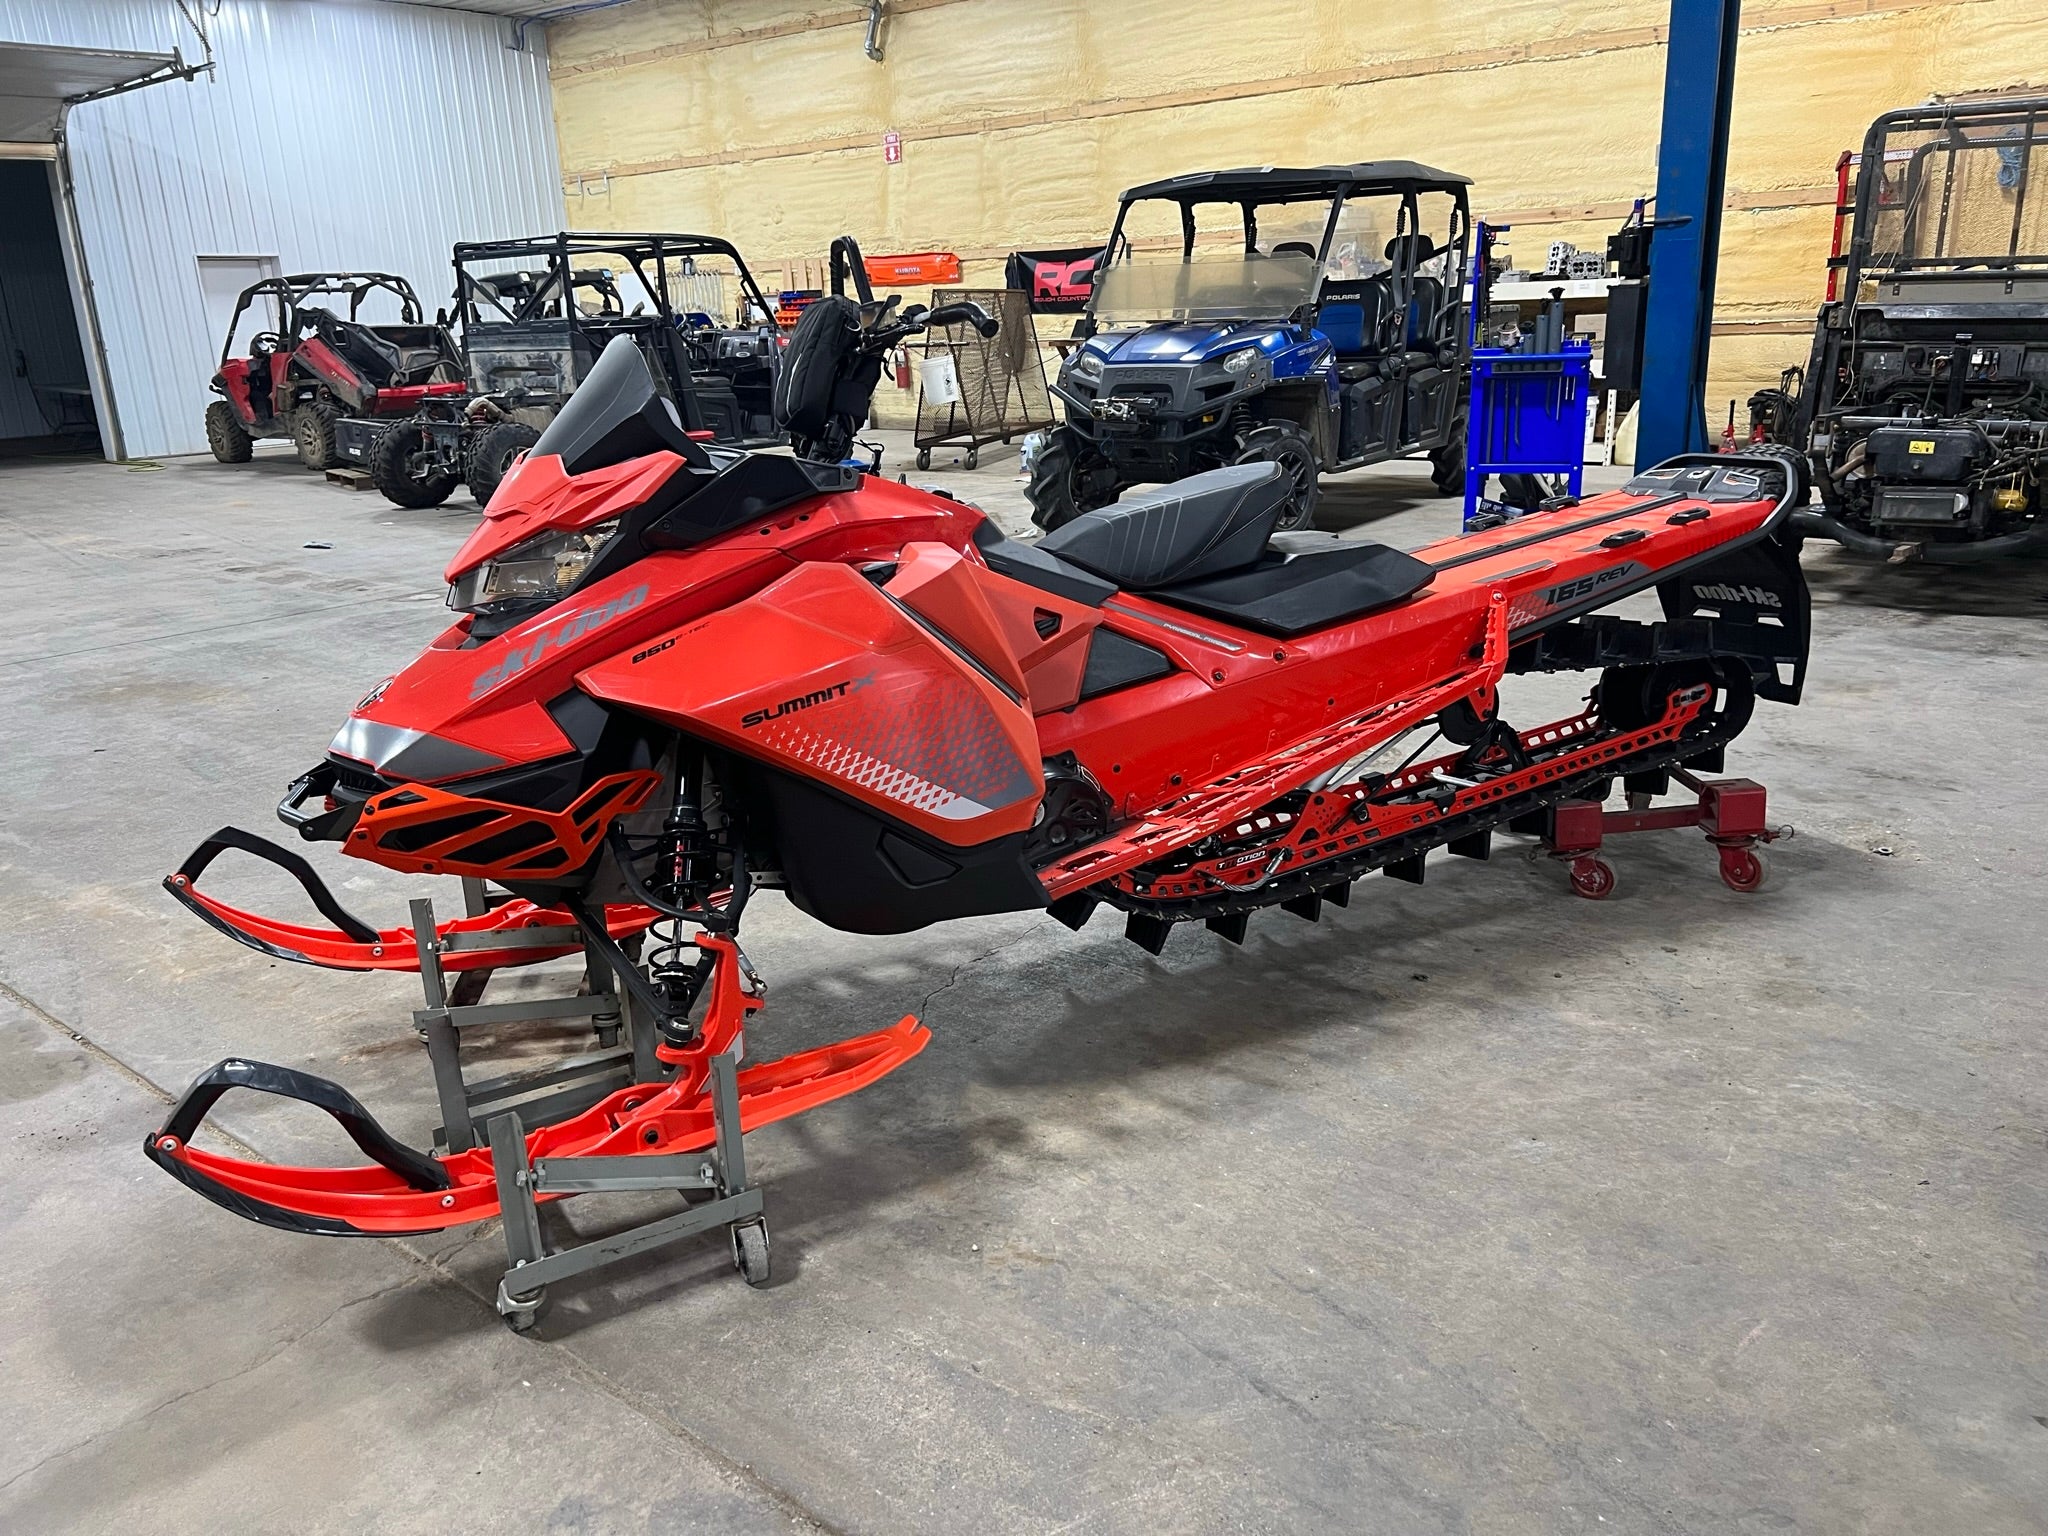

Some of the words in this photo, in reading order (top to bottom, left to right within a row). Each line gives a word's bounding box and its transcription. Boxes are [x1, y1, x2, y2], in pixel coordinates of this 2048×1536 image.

[1034, 259, 1095, 296] RC
[1545, 576, 1595, 606] 165
[1596, 563, 1634, 584] REV
[632, 637, 676, 665] 850
[741, 681, 851, 729] SUMMIT
